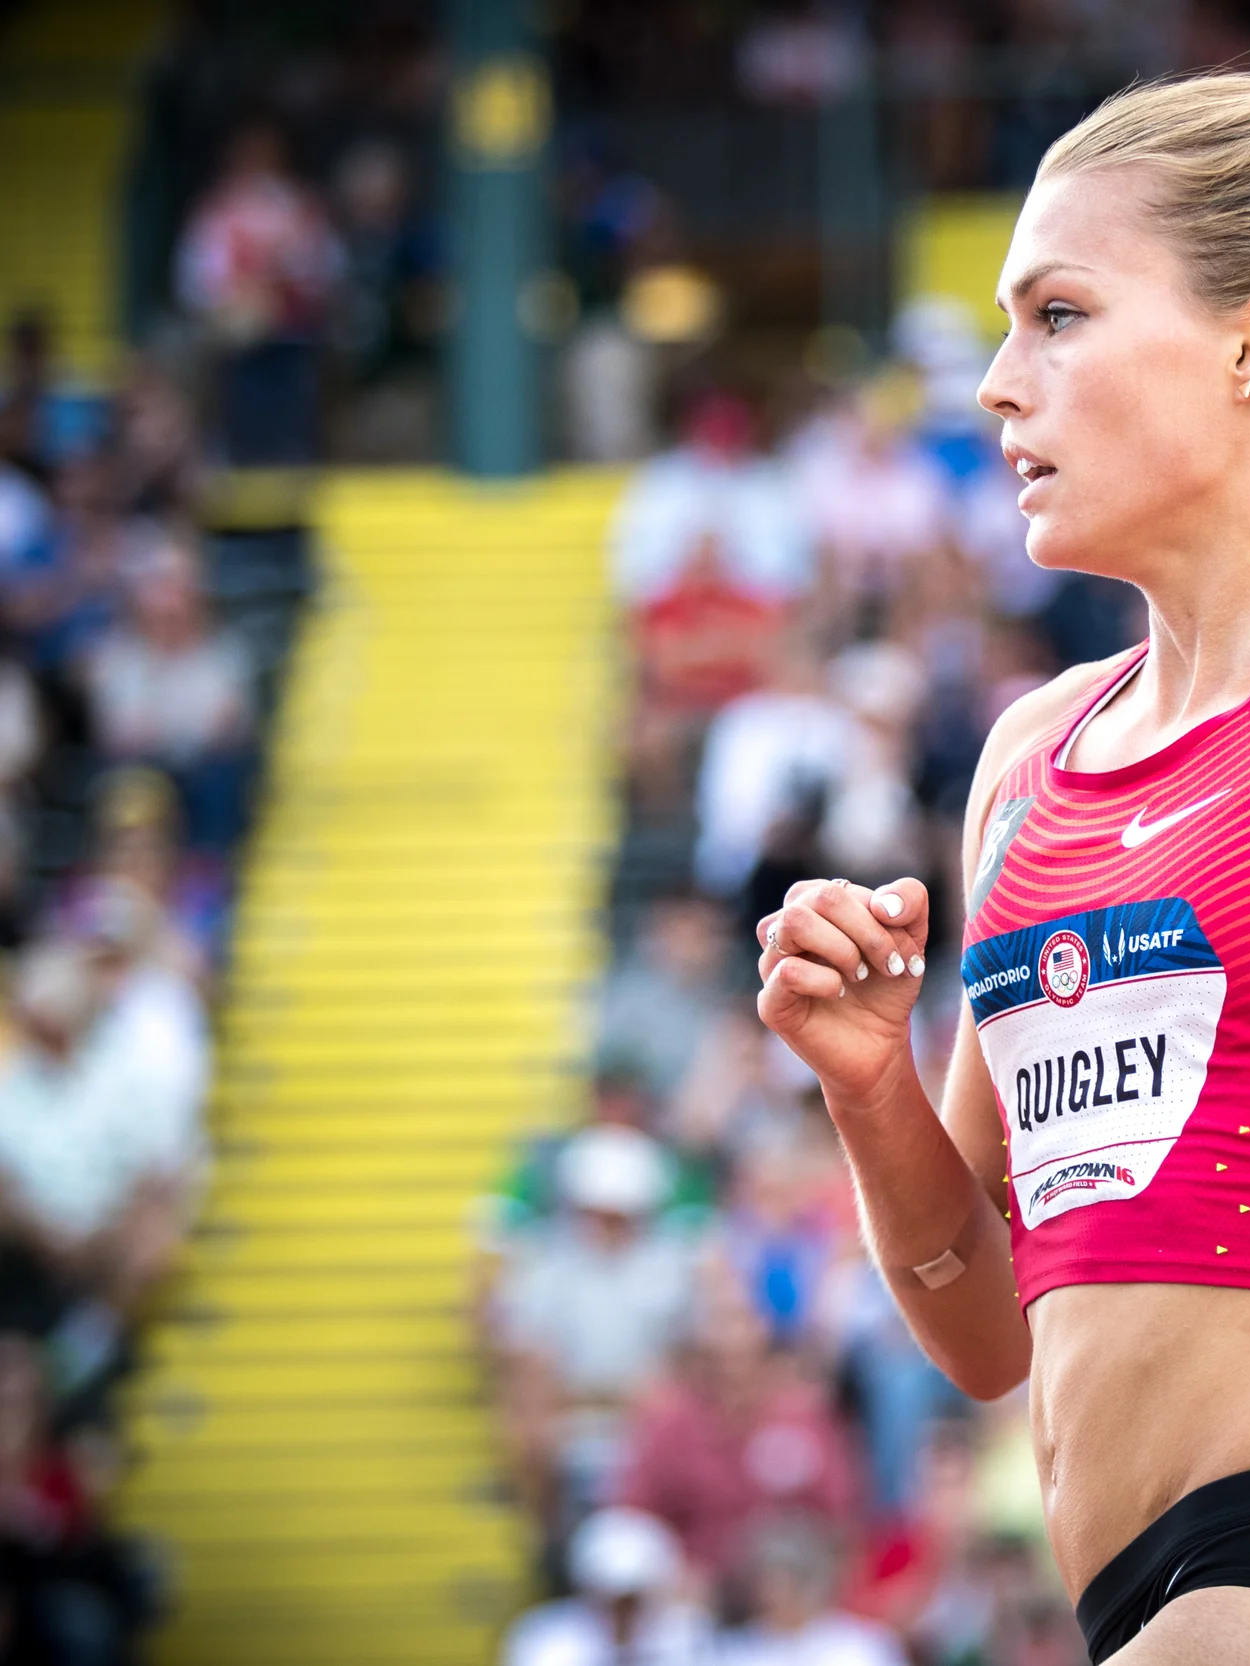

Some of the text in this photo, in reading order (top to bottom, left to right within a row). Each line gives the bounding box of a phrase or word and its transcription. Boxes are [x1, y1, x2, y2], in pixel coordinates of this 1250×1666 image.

[1043, 934, 1084, 962] UNITED STATES
[1129, 929, 1184, 953] USATF
[1044, 974, 1087, 1005] OLYMPIC TEAM
[1016, 1034, 1166, 1132] QUIGLEY
